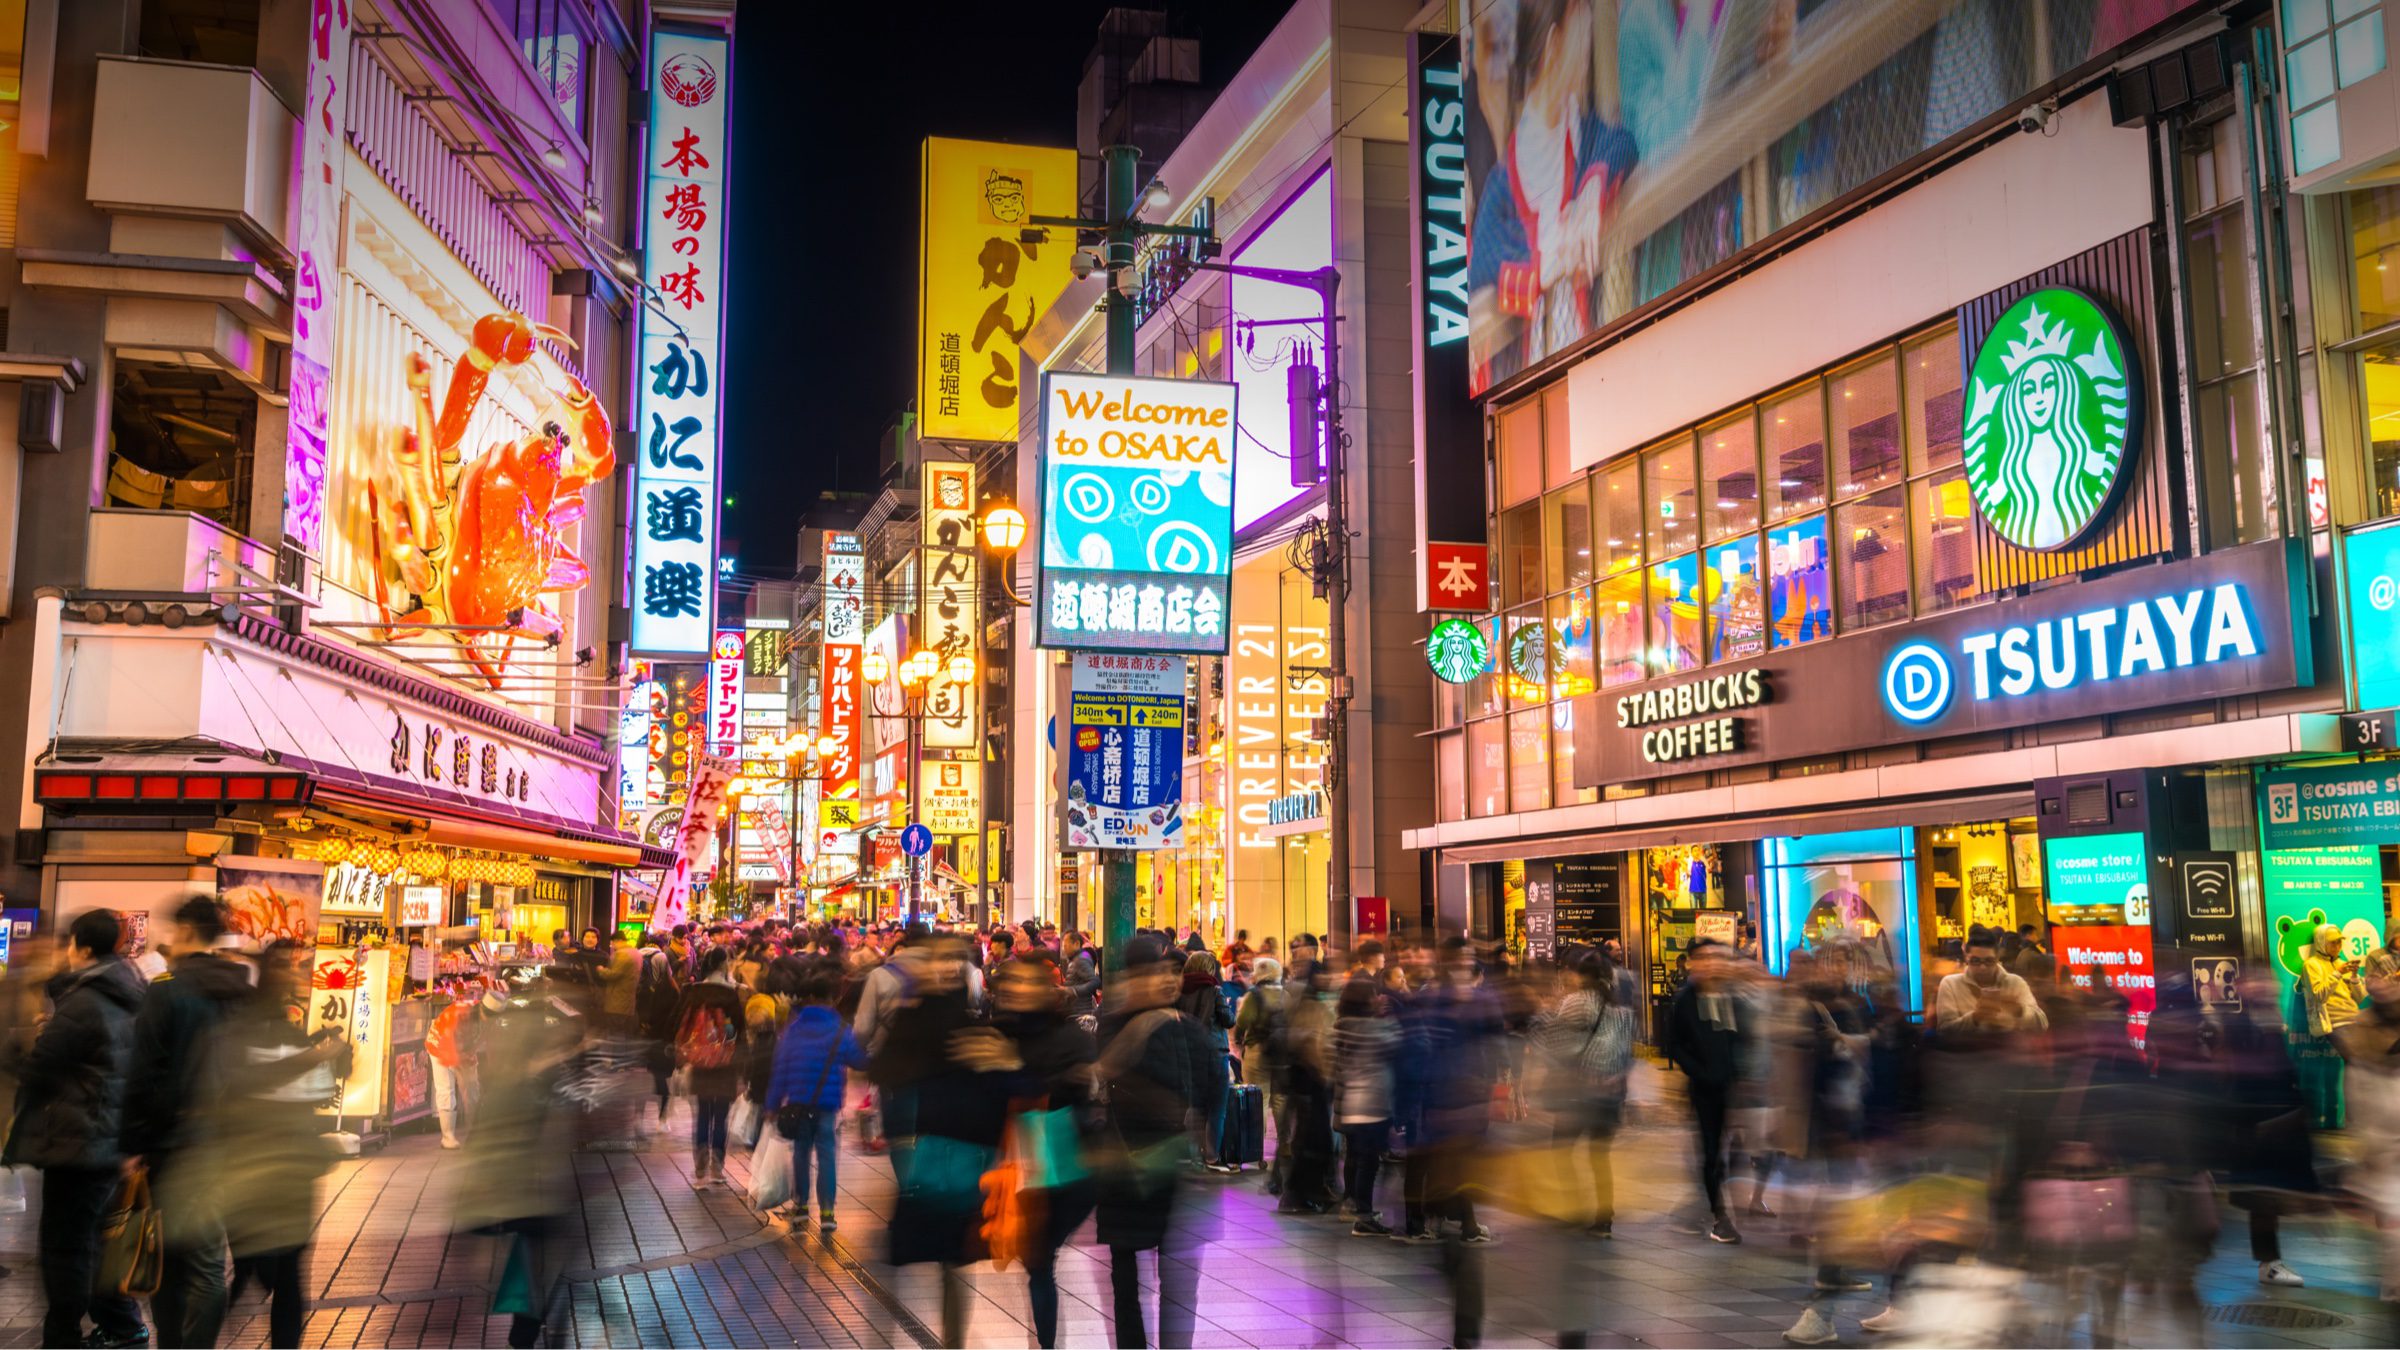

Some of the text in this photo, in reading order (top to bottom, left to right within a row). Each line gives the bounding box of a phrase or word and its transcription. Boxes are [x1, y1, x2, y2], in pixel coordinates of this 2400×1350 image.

[1425, 61, 1470, 347] TSUTAYA
[660, 126, 710, 311] 本場の味
[938, 332, 961, 417] 道頓堀店
[1056, 388, 1229, 427] Welcome
[1055, 429, 1228, 464] to OSAKA
[643, 342, 709, 618] かに道楽
[1437, 556, 1478, 597] 本
[1051, 580, 1222, 635] 道頓堀商店会
[1237, 624, 1276, 659] 21
[1962, 583, 2257, 701] TSUTAYA
[1087, 655, 1172, 671] 道頓堀商店会
[717, 662, 738, 759] ジャンカラ
[1075, 693, 1106, 702] Welcome
[1107, 694, 1115, 702] to
[1160, 697, 1180, 706] Japan
[1617, 668, 1761, 728] STARBUCKS
[830, 648, 853, 780] ツルハドラッグ
[1075, 706, 1103, 717] 340m
[1151, 709, 1178, 720] 240m
[1078, 738, 1099, 747] OPEN!
[1080, 731, 1096, 740] NEW
[1642, 717, 1734, 763] COFFEE
[2357, 719, 2381, 744] 3F
[1083, 753, 1091, 773] STORE
[1238, 675, 1277, 848] FOREVER
[2302, 779, 2378, 800] @cosme
[1268, 791, 1317, 825] FOREVER 21
[2273, 794, 2294, 819] 3F
[2303, 802, 2370, 821] TSUTAYA
[1103, 817, 1149, 836] EDION
[2055, 857, 2099, 869] @cosme
[2102, 854, 2133, 867] store
[2271, 856, 2373, 866] TSUTAYA EBISUBASHI
[327, 867, 386, 907] かに寿司
[2060, 872, 2139, 885] TSUTAYA EBISUBASHI
[2190, 934, 2226, 942] Free Wi-Fi
[2351, 936, 2370, 956] 3F
[2067, 947, 2143, 965] Welcome to
[2117, 971, 2156, 988] store
[355, 990, 371, 1044] 本場の味
